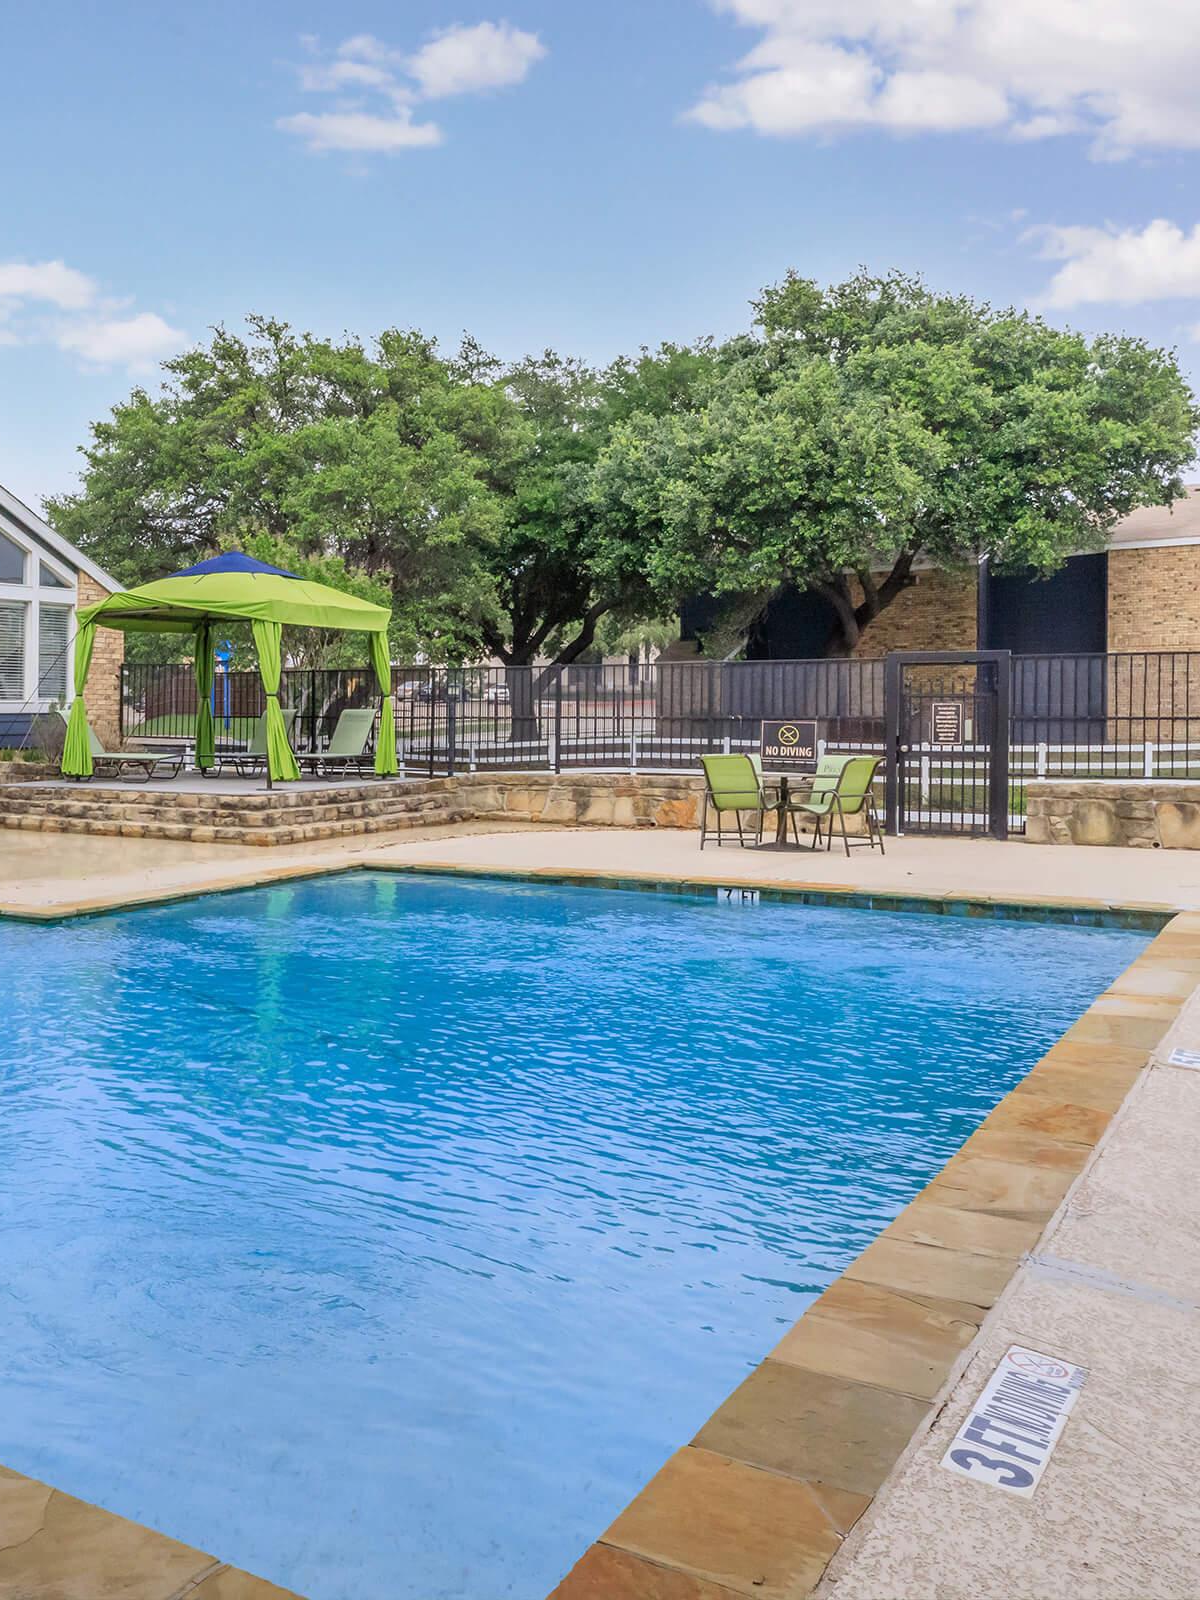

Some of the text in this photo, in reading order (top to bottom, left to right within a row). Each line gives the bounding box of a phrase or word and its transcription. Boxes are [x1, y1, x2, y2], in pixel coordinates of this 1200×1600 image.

[765, 746, 812, 757] NO DIVING
[741, 890, 757, 905] FT
[991, 1371, 1071, 1423] DIVING
[983, 1403, 1053, 1438] NO
[950, 1448, 1034, 1488] 3
